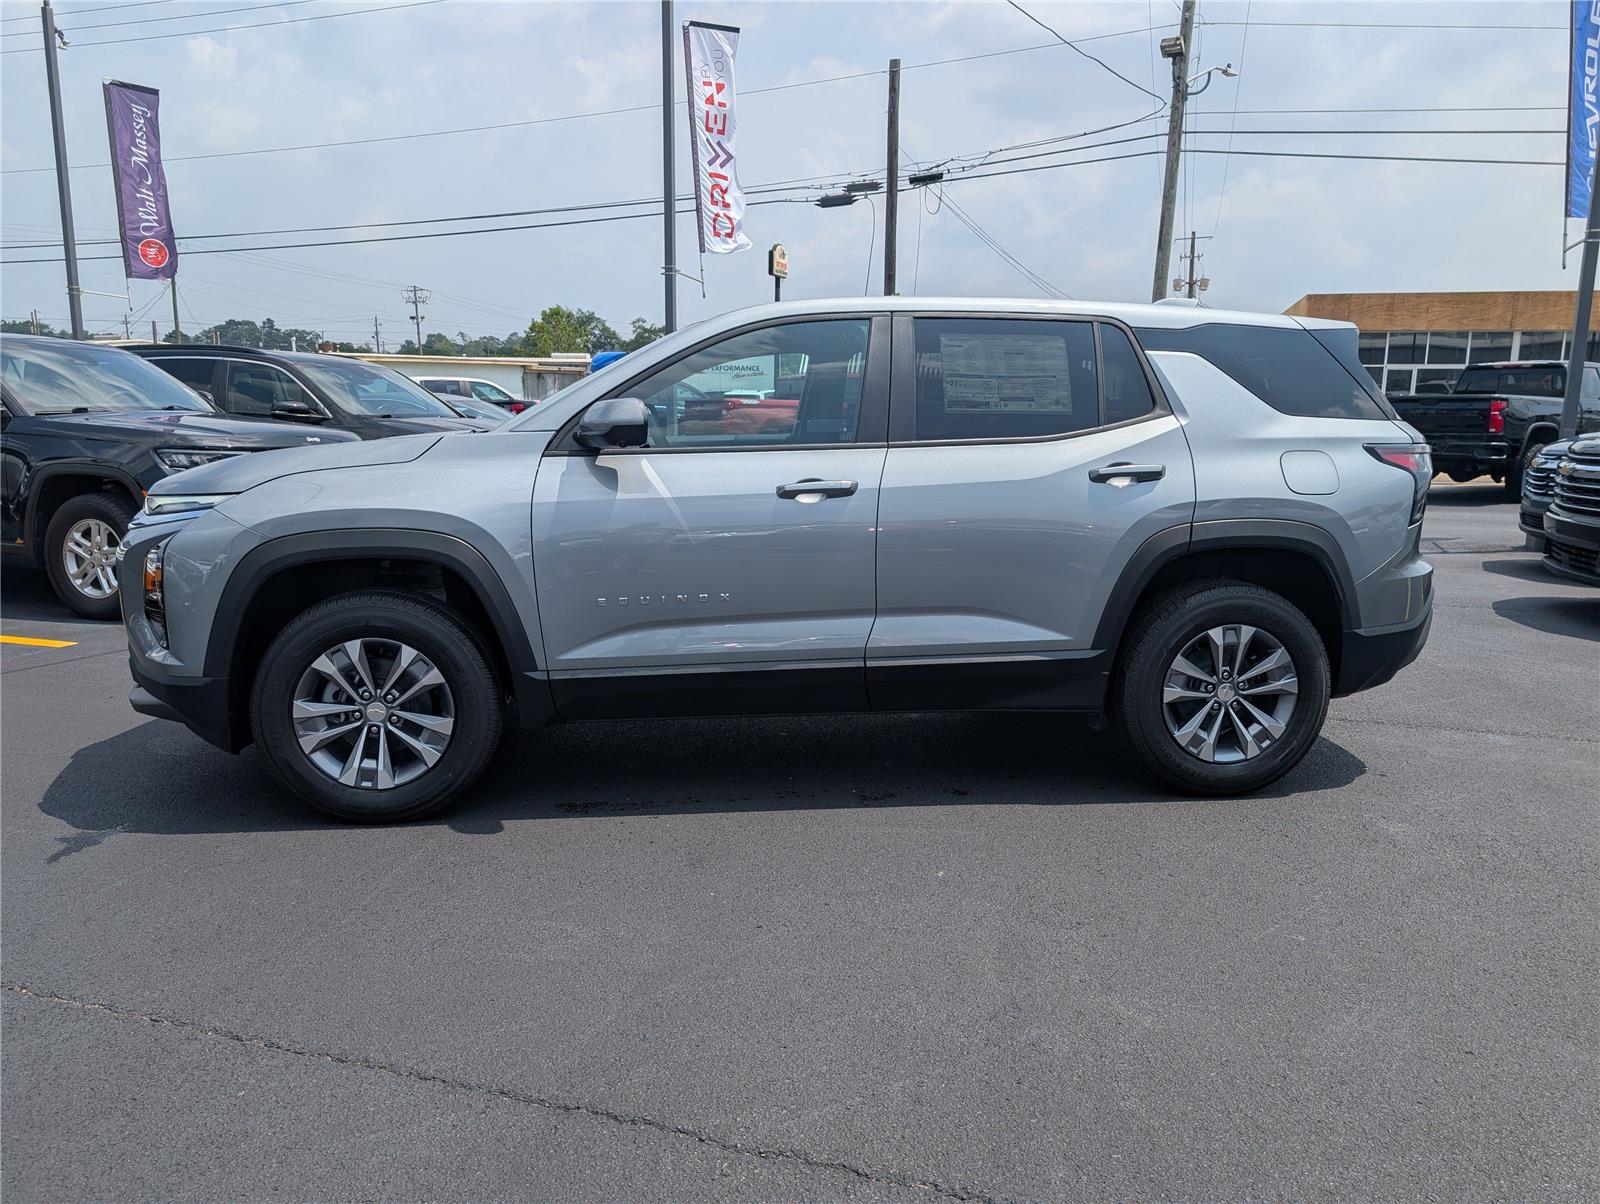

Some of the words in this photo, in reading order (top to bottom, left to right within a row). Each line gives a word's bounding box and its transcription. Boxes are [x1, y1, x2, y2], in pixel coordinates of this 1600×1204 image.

[701, 60, 711, 79] BY
[714, 49, 725, 81] YOU
[131, 103, 152, 185] Massey
[139, 188, 160, 236] Walt
[597, 592, 731, 606] EQUINOX
